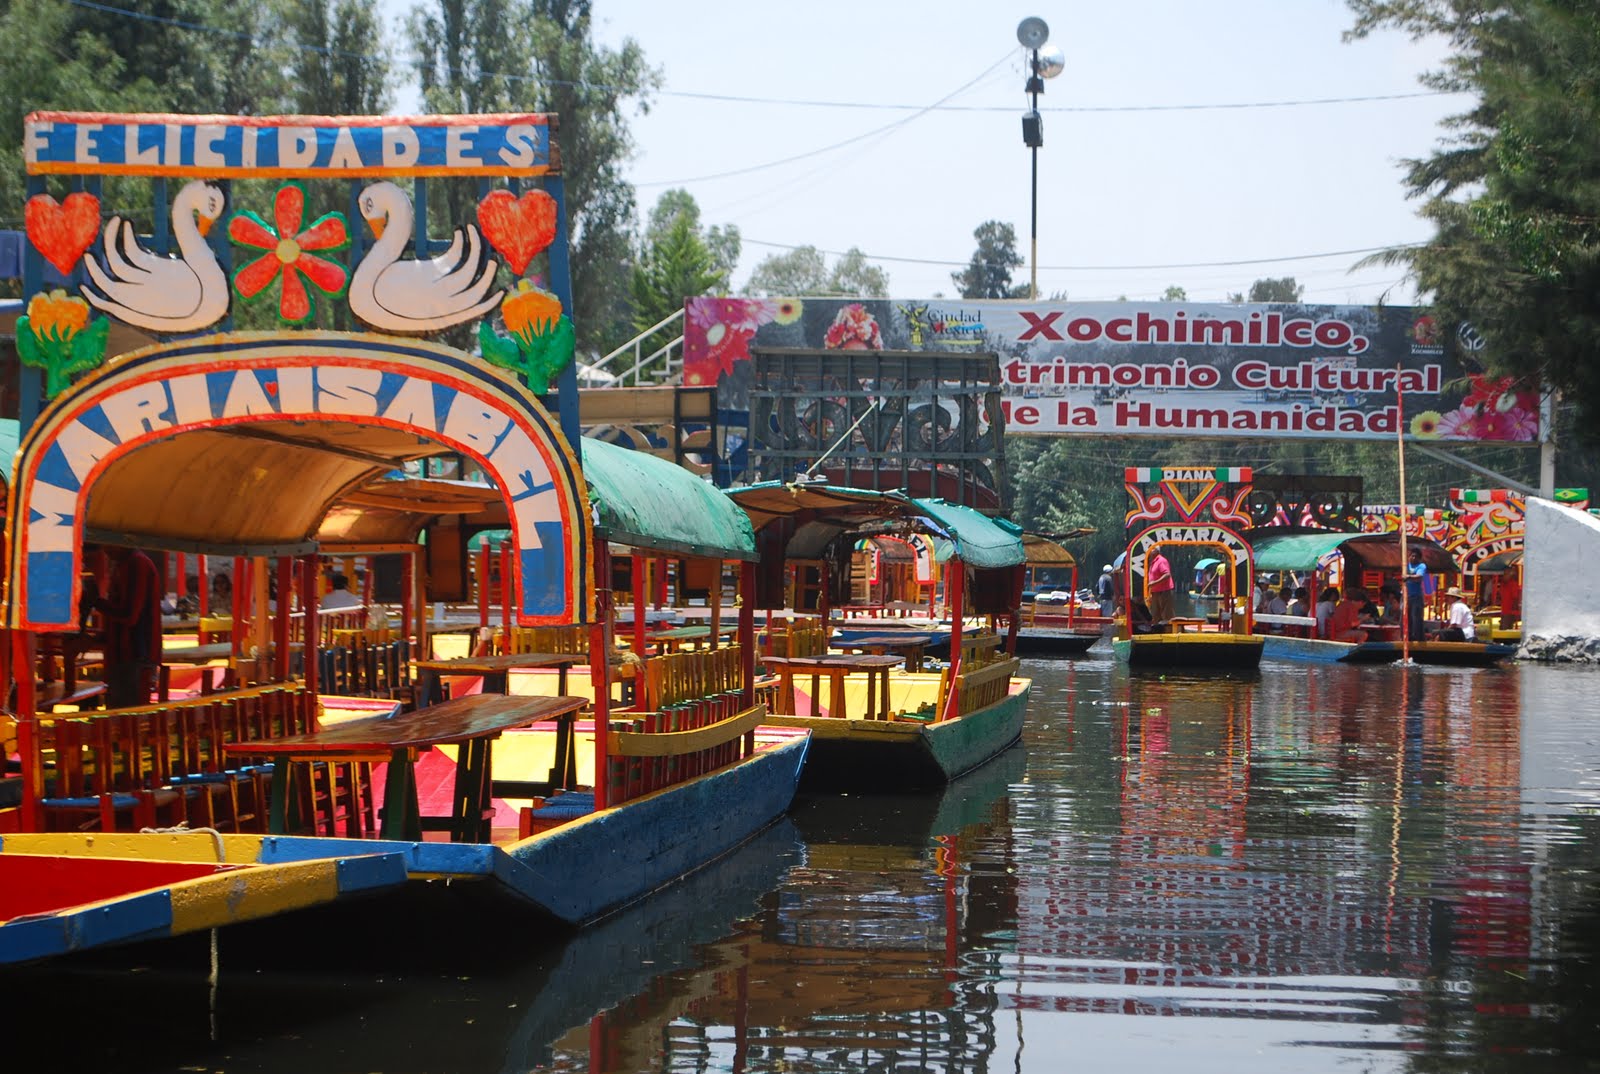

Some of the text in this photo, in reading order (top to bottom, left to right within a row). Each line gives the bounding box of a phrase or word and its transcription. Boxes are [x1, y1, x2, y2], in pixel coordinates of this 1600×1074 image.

[27, 122, 541, 170] FELICIDADES
[928, 309, 981, 322] Ciudad
[1020, 312, 1369, 356] Xochimilco,
[997, 359, 1439, 391] trimonio Cultural
[1058, 401, 1099, 426] la
[1116, 403, 1399, 432] Humanidad
[1162, 470, 1216, 481] DIANA
[1131, 528, 1249, 577] MARGARITA
